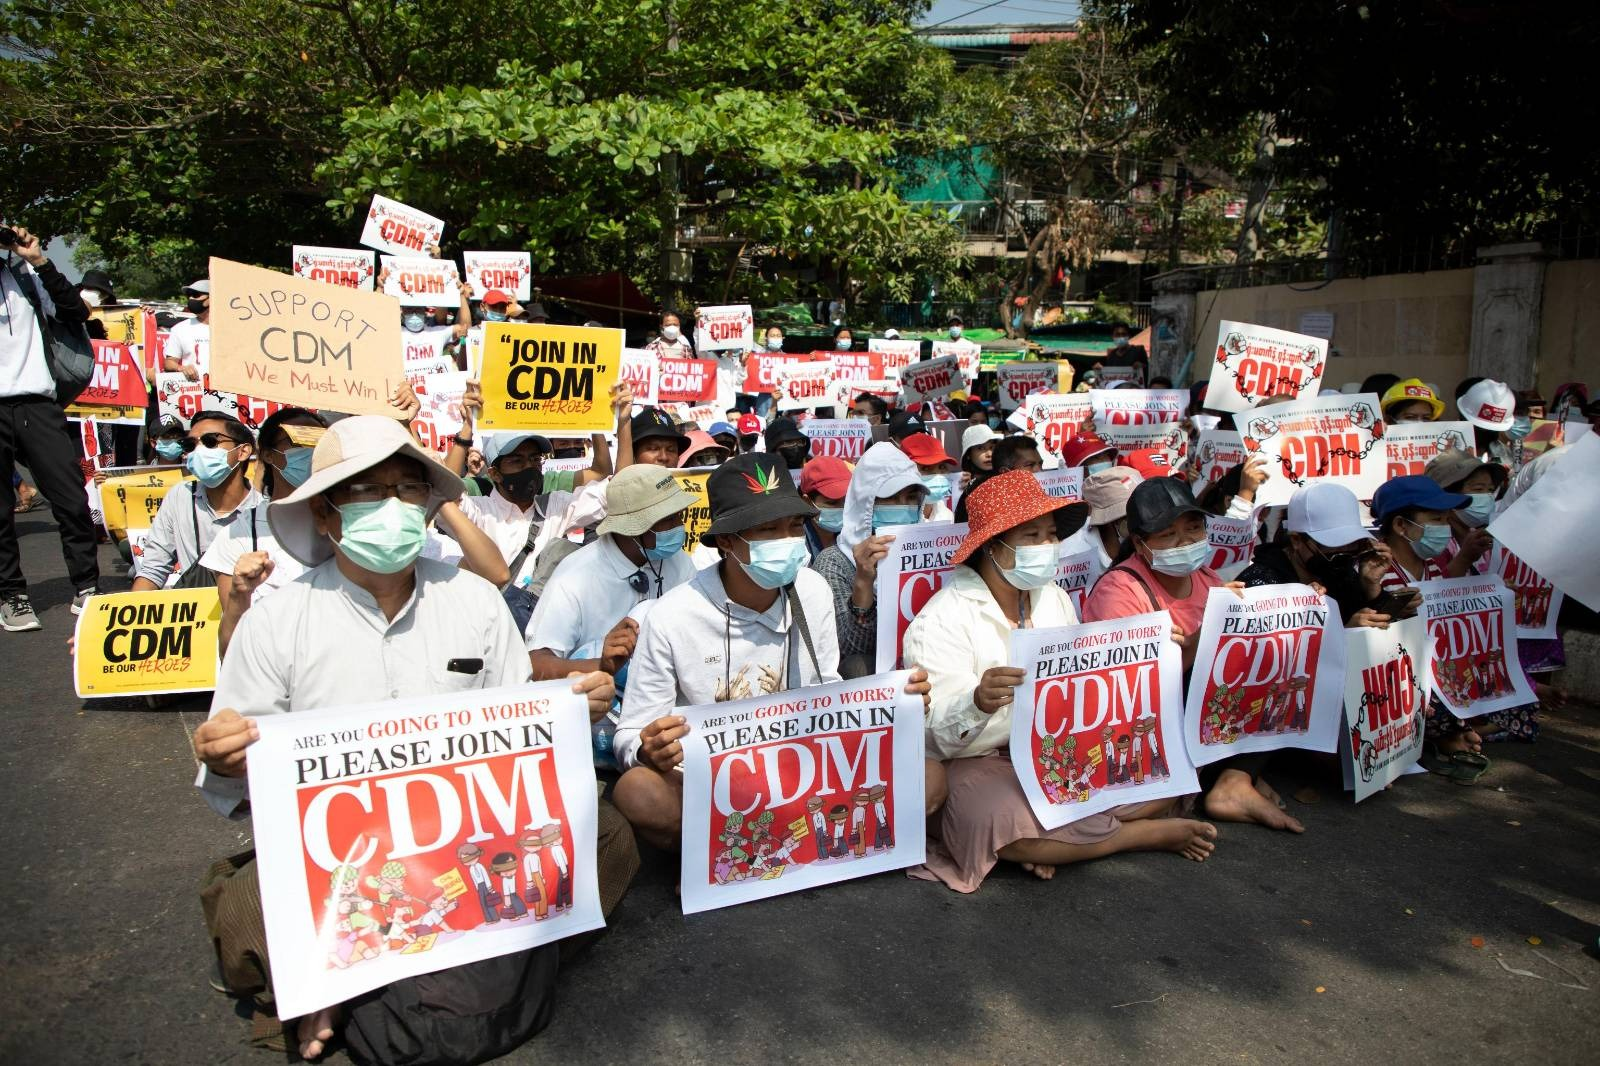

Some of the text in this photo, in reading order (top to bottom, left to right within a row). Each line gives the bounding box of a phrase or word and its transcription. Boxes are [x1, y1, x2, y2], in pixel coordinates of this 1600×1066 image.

[380, 218, 426, 251] CDM
[400, 271, 445, 295] CDM
[481, 269, 520, 290] CDM
[229, 290, 377, 340] SUPPORT
[710, 322, 743, 341] CDM
[98, 346, 121, 364] IN
[260, 326, 353, 371] CDM
[572, 342, 598, 365] IN
[881, 352, 910, 368] CDM
[619, 362, 651, 382] DM
[690, 362, 704, 375] IN
[857, 355, 870, 366] IN
[244, 361, 279, 384] We
[290, 369, 338, 394] Must
[789, 378, 826, 399] CDM
[913, 371, 952, 394] CDM
[1235, 358, 1303, 399] CDM
[505, 399, 593, 416] BE OUR HEROES
[1145, 402, 1166, 410] JOIN
[810, 437, 864, 458] CDM
[1280, 433, 1361, 480] CDM
[1069, 483, 1078, 495] IN
[1212, 523, 1245, 534] GOING
[901, 541, 918, 552] ARE
[919, 539, 936, 550] YOU
[901, 551, 954, 572] PLEAS
[1074, 572, 1091, 587] IN
[1441, 588, 1462, 600] GOING
[1462, 586, 1470, 596] TO
[1472, 583, 1496, 595] WORK?
[170, 602, 198, 623] IN
[1226, 603, 1242, 613] ARE
[1255, 598, 1277, 612] GOING
[1277, 597, 1288, 608] TO
[1427, 594, 1504, 618] PLEASE JOIN IN
[1222, 615, 1274, 634] PLEASE
[1306, 610, 1328, 627] IN
[1038, 625, 1162, 656] ARE YOU GOING TO WORK?
[1428, 611, 1502, 661] CDM
[102, 656, 192, 676] BE OUR HEROES
[1035, 641, 1161, 679] PLEASE JOIN IN
[1212, 630, 1318, 689] CDM
[1034, 664, 1156, 739] CDM
[1362, 654, 1415, 732] CDM
[701, 687, 896, 729] ARE YOU GOING TO WORK?
[293, 698, 550, 751] ARE YOU GOING TO WORK?
[704, 706, 896, 754] PLEASE JOIN IN
[295, 721, 555, 785] PLEASE JOIN IN
[713, 730, 888, 817] CDM
[303, 752, 562, 873] CDM
